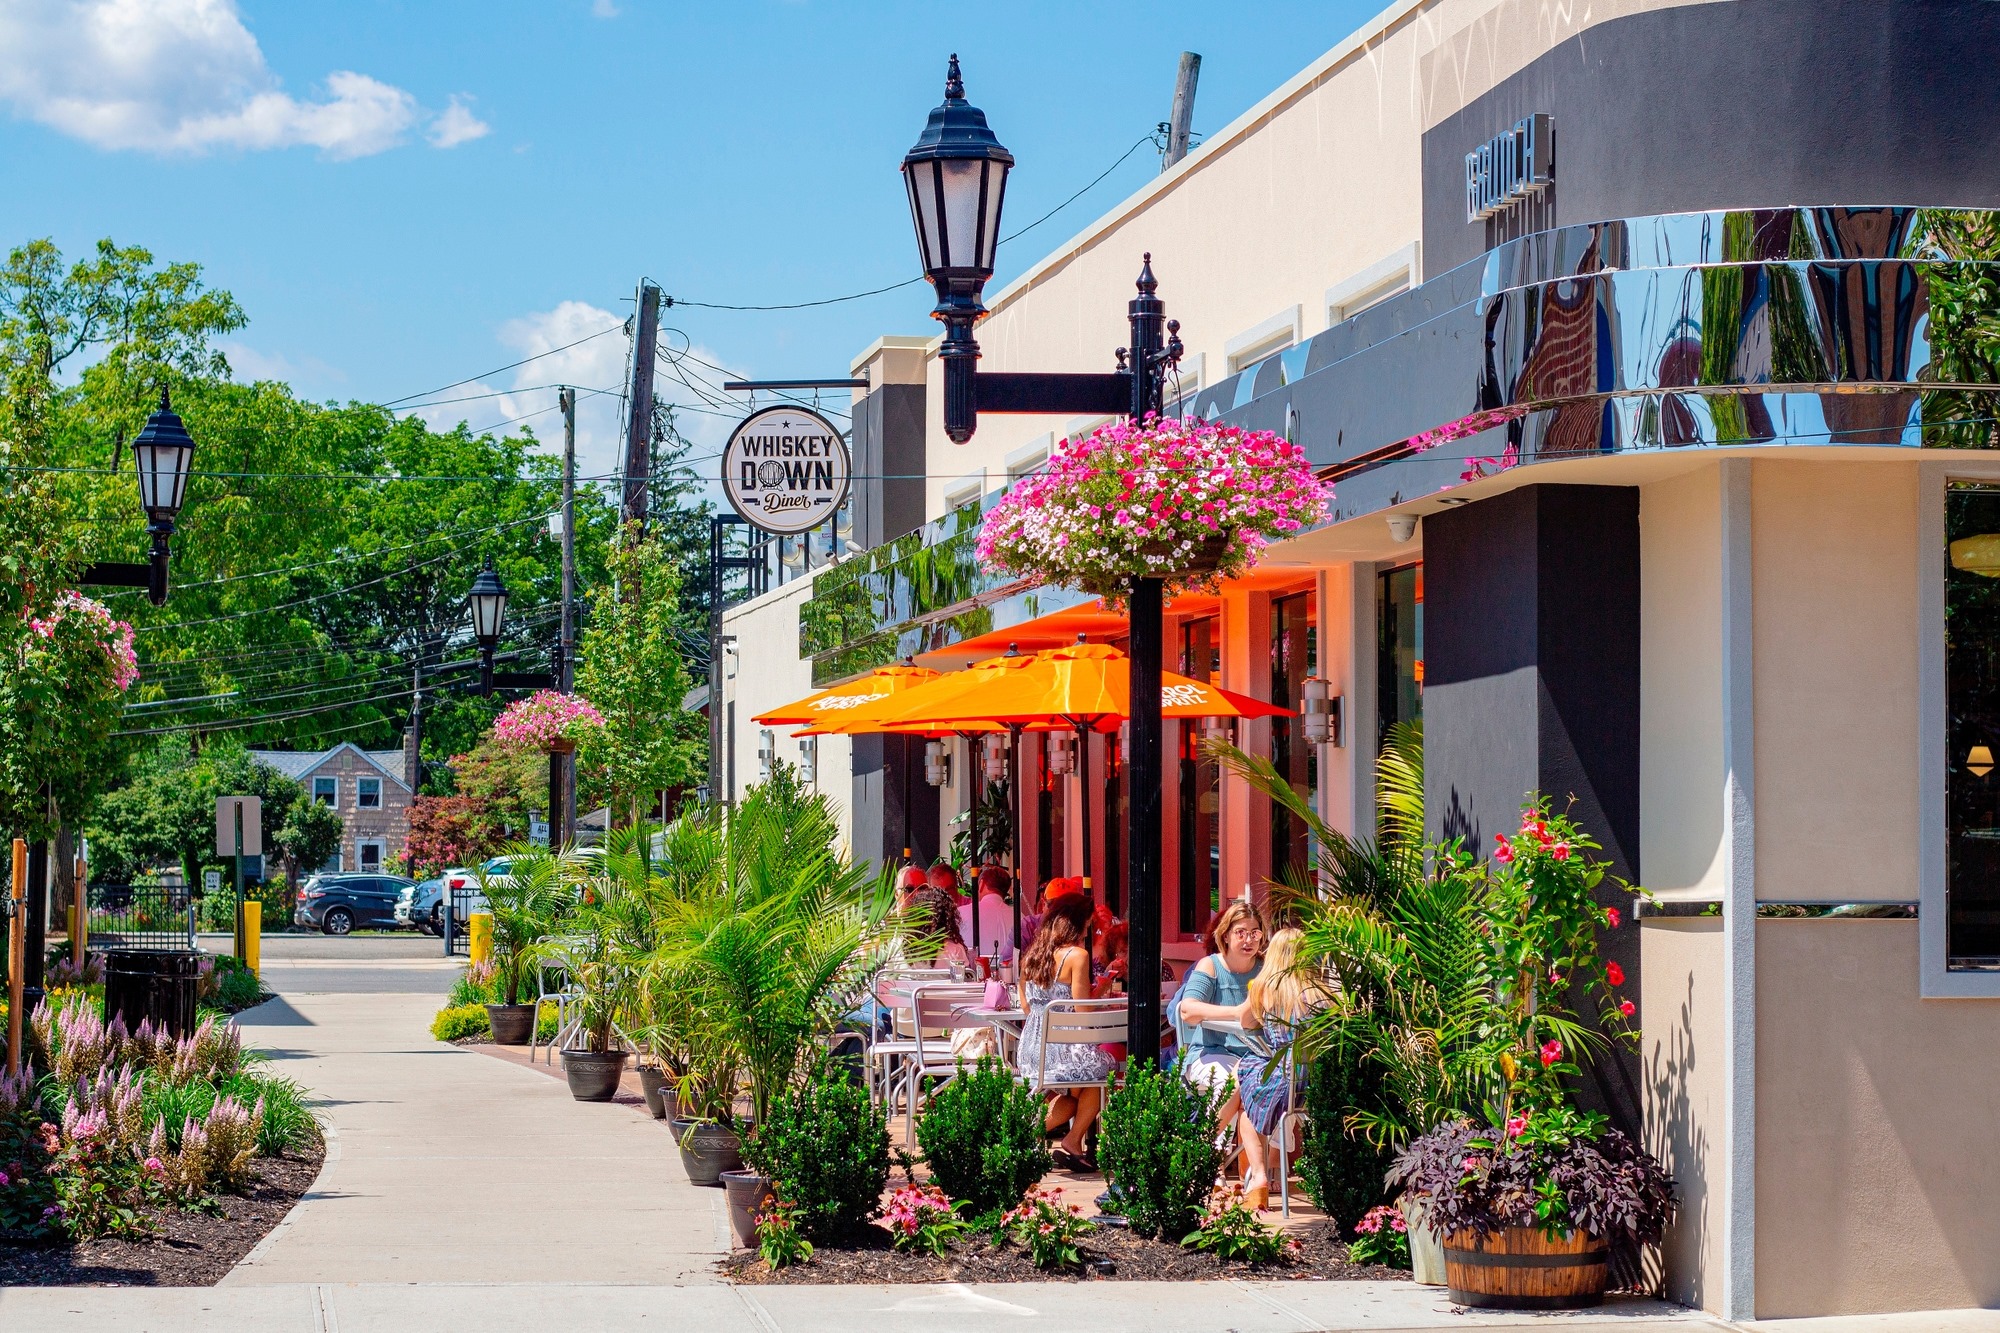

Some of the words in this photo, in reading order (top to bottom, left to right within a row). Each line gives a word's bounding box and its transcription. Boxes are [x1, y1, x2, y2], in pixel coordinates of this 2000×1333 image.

[740, 435, 834, 457] WHISKEY
[740, 460, 834, 492] DOWN
[763, 492, 812, 512] Diner
[1161, 684, 1208, 699] EROL
[1161, 693, 1208, 708] PRITZ
[538, 824, 548, 832] ALL
